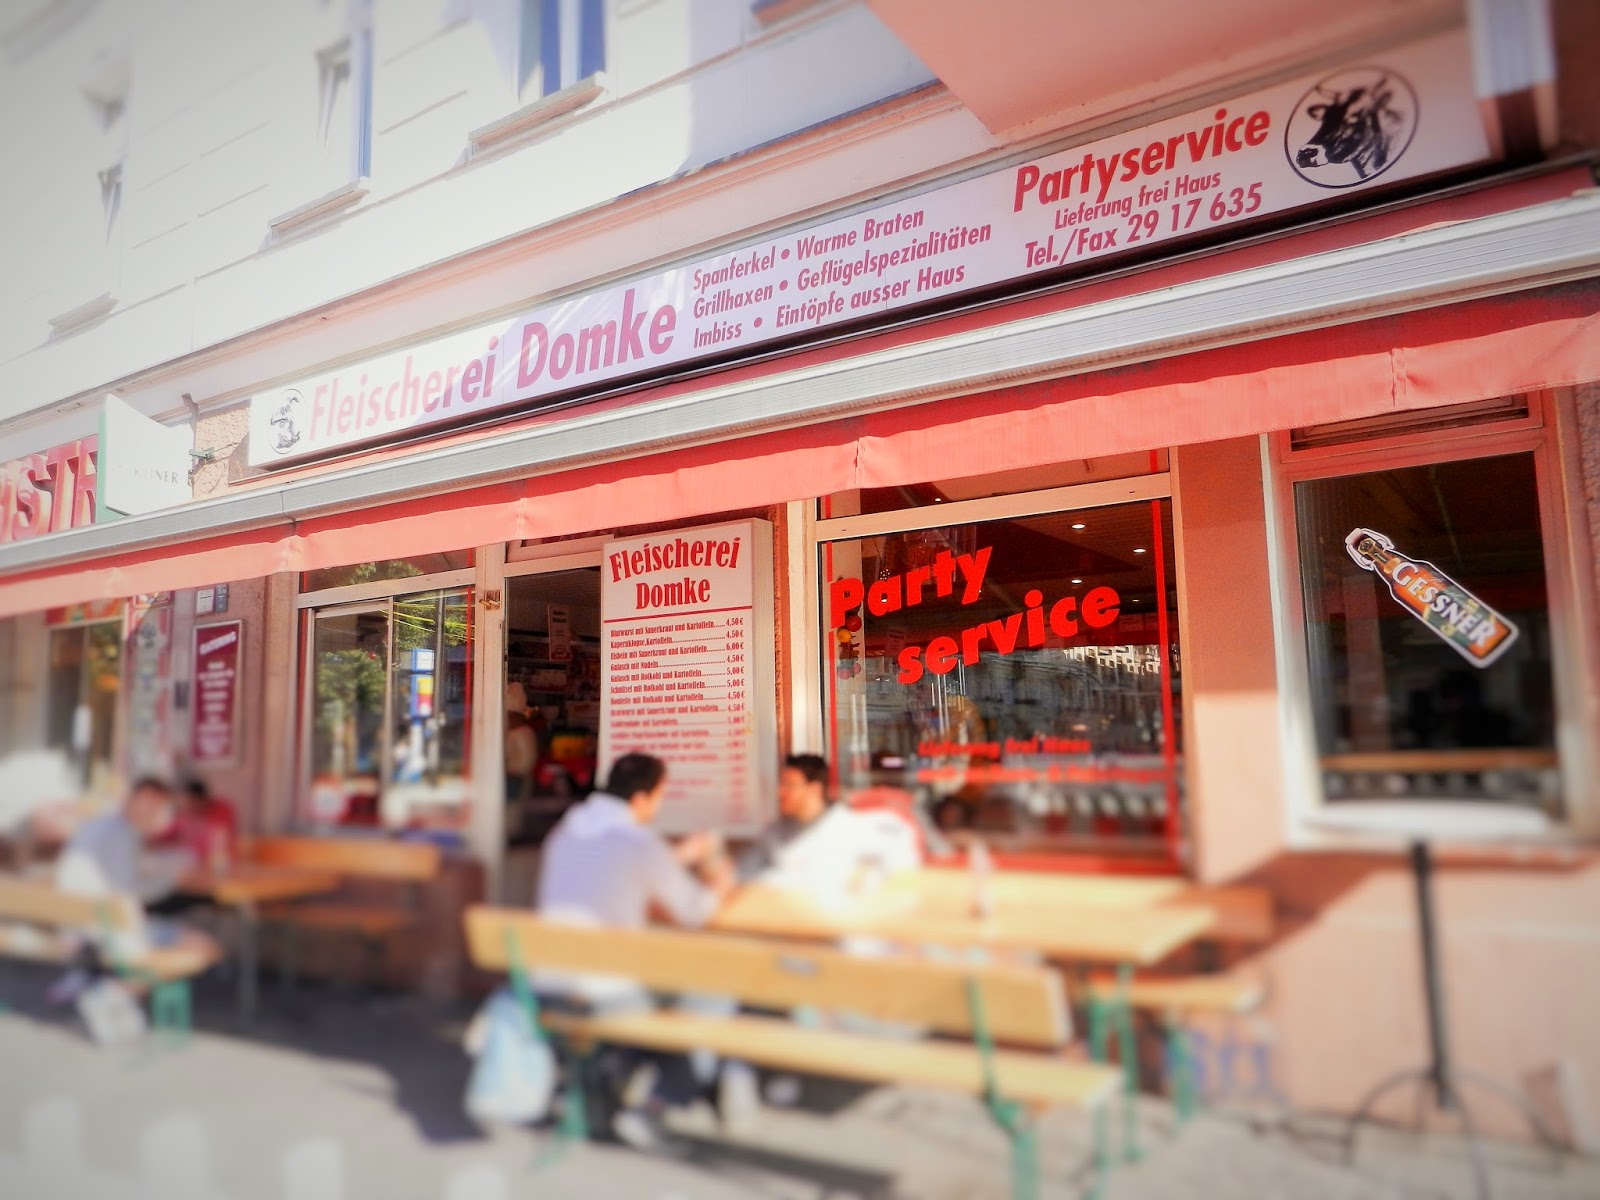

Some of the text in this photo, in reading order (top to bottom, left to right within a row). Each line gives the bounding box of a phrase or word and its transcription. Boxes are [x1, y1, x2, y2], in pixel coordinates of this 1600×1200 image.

[1013, 108, 1271, 212] Partyservice
[1055, 169, 1221, 230] Lieferung frei Haus
[693, 210, 924, 294] Spanferkel Warme Braten
[1025, 182, 1263, 268] Tel./Fax 29 17 635
[693, 223, 992, 319] Grillhaxen Geflügelspezialitäten
[693, 264, 965, 348] Imbiss Eintöpfe ausser Haus
[308, 288, 677, 440] Fleischerei Domke
[609, 537, 741, 583] Fleischerei
[636, 577, 711, 610] Domke
[830, 546, 993, 629] Party
[675, 623, 685, 631] und
[898, 587, 1121, 684] service
[1392, 561, 1497, 647] GESSNER
